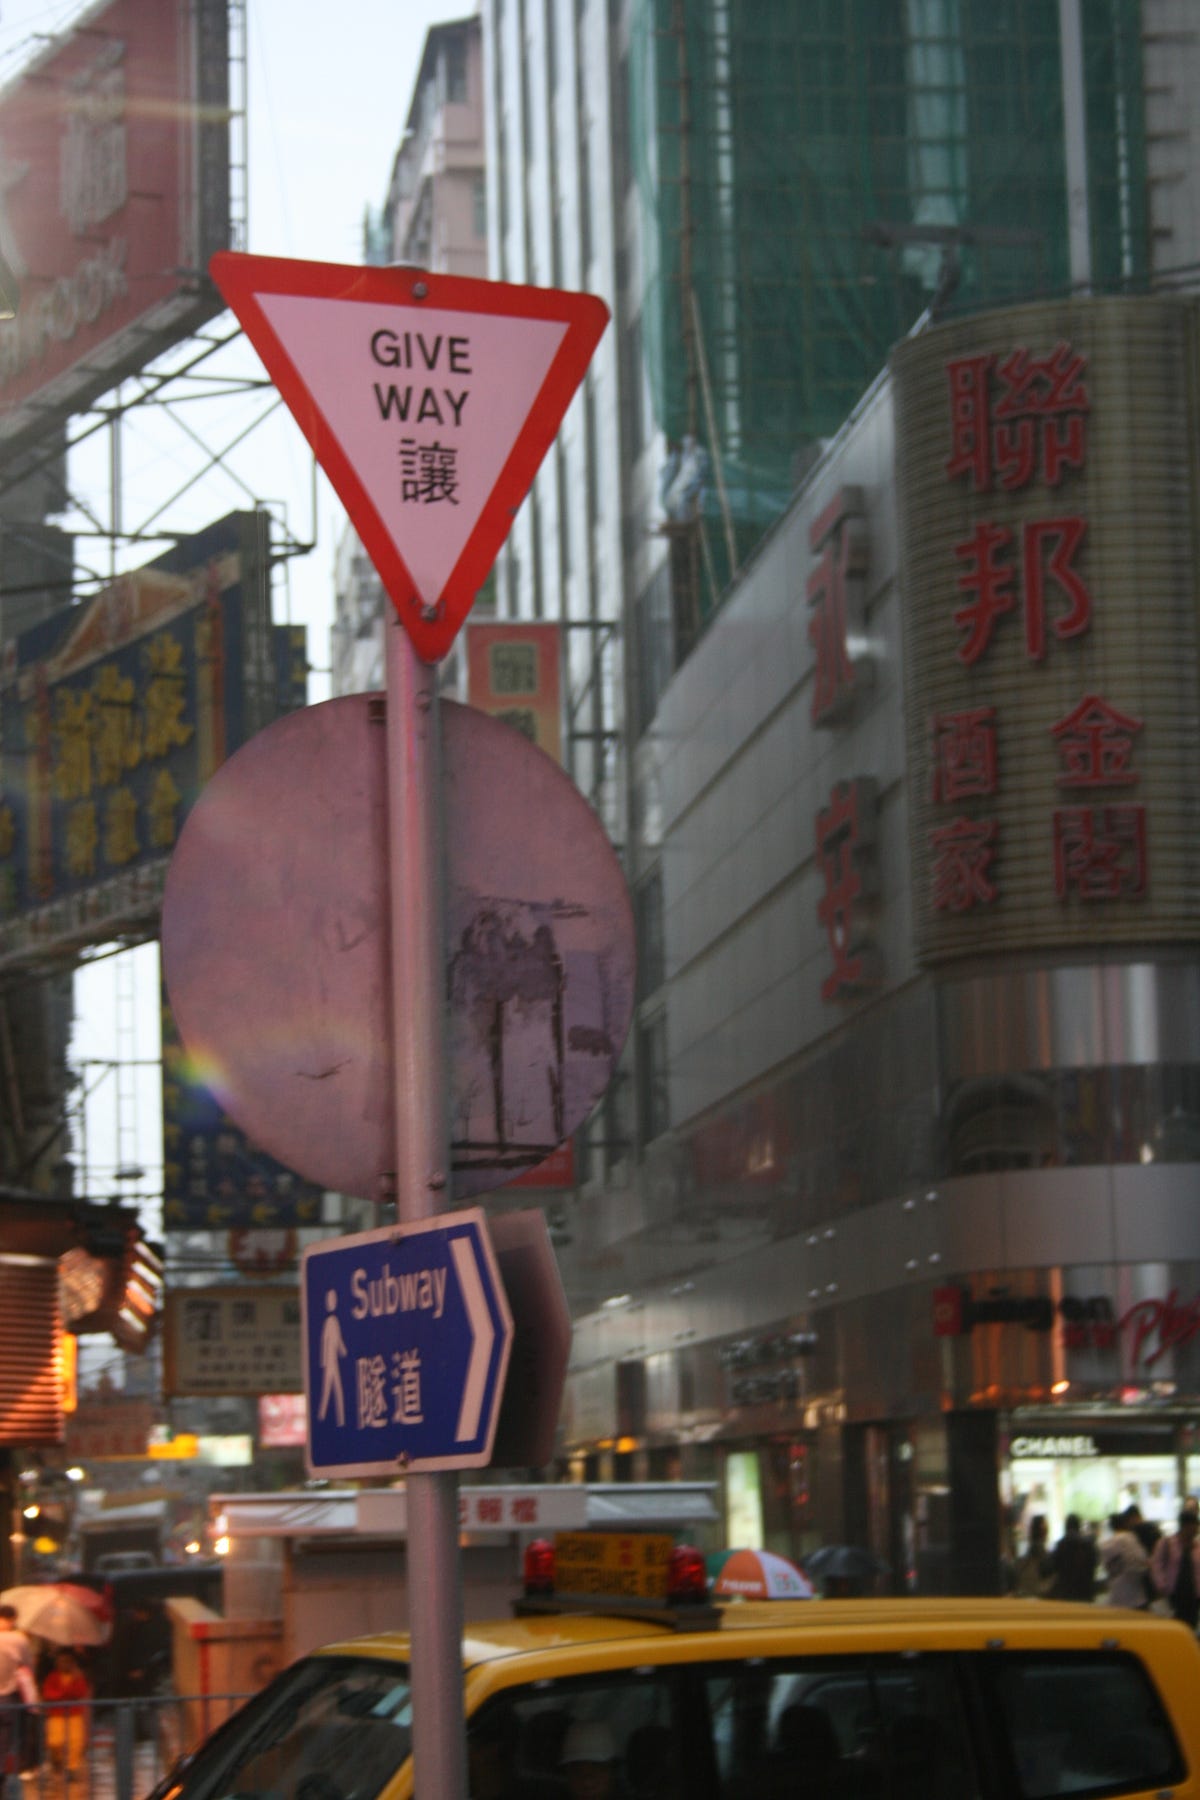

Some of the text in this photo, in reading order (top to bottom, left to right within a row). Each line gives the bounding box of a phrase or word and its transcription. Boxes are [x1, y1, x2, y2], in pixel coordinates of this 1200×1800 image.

[370, 329, 473, 375] GIVE
[373, 382, 470, 427] WAY
[399, 438, 460, 506] 讓
[945, 345, 1092, 667] 聯邦
[930, 706, 1001, 912] 酒家
[1049, 694, 1148, 902] 金閣
[352, 1263, 448, 1320] Subway
[356, 1348, 425, 1430] 隧道
[1011, 1436, 1099, 1457] CHANEL
